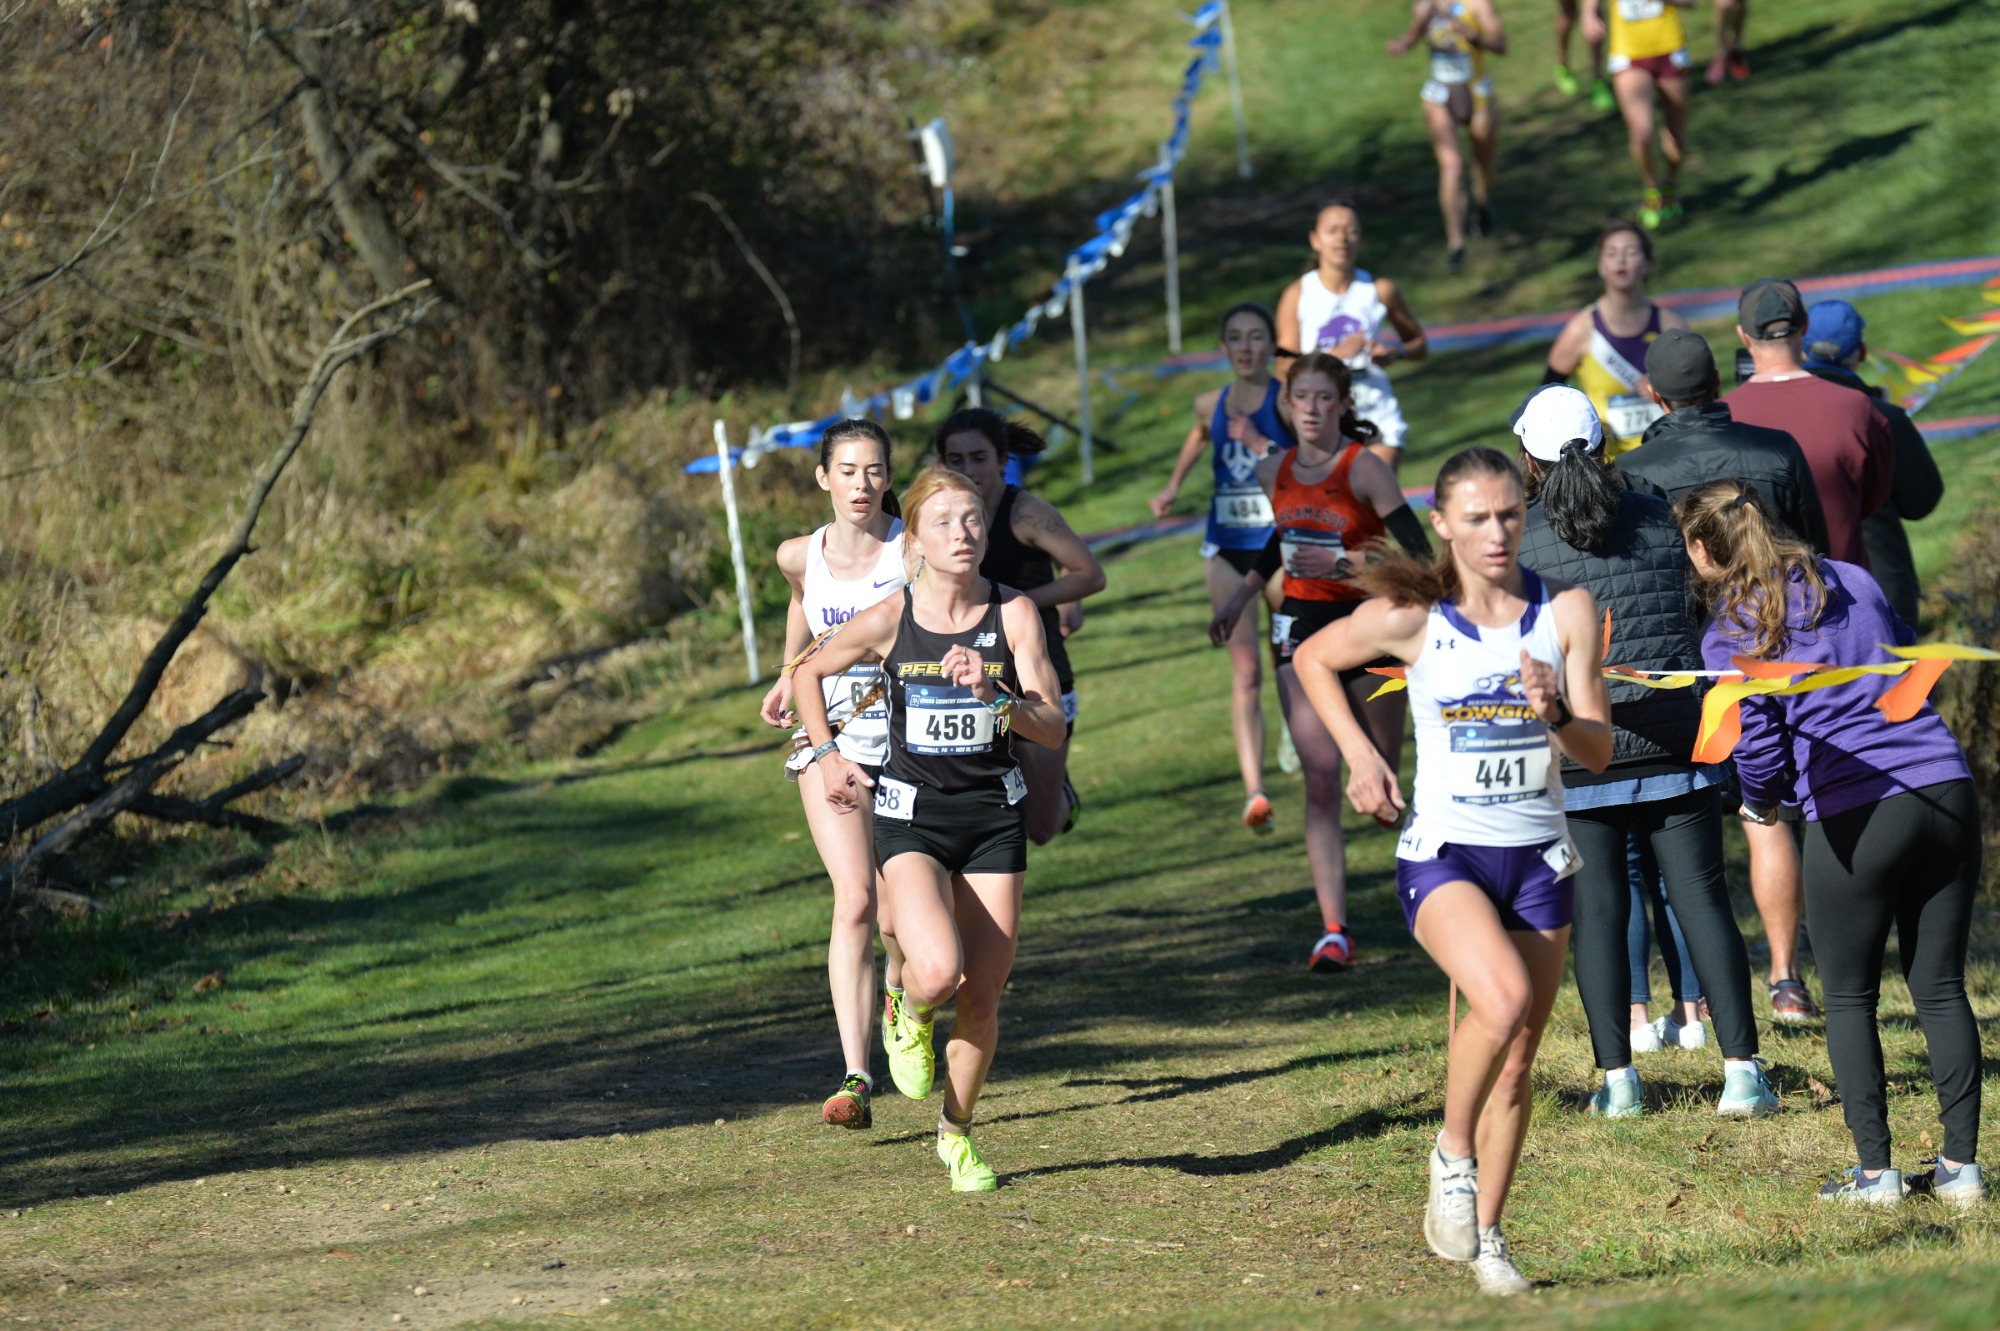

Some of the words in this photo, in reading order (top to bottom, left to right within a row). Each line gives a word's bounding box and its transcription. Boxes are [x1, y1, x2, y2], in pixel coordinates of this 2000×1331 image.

[1441, 705, 1538, 722] COWGIR
[926, 714, 976, 741] 458
[1475, 756, 1526, 789] 441
[875, 784, 901, 810] 58
